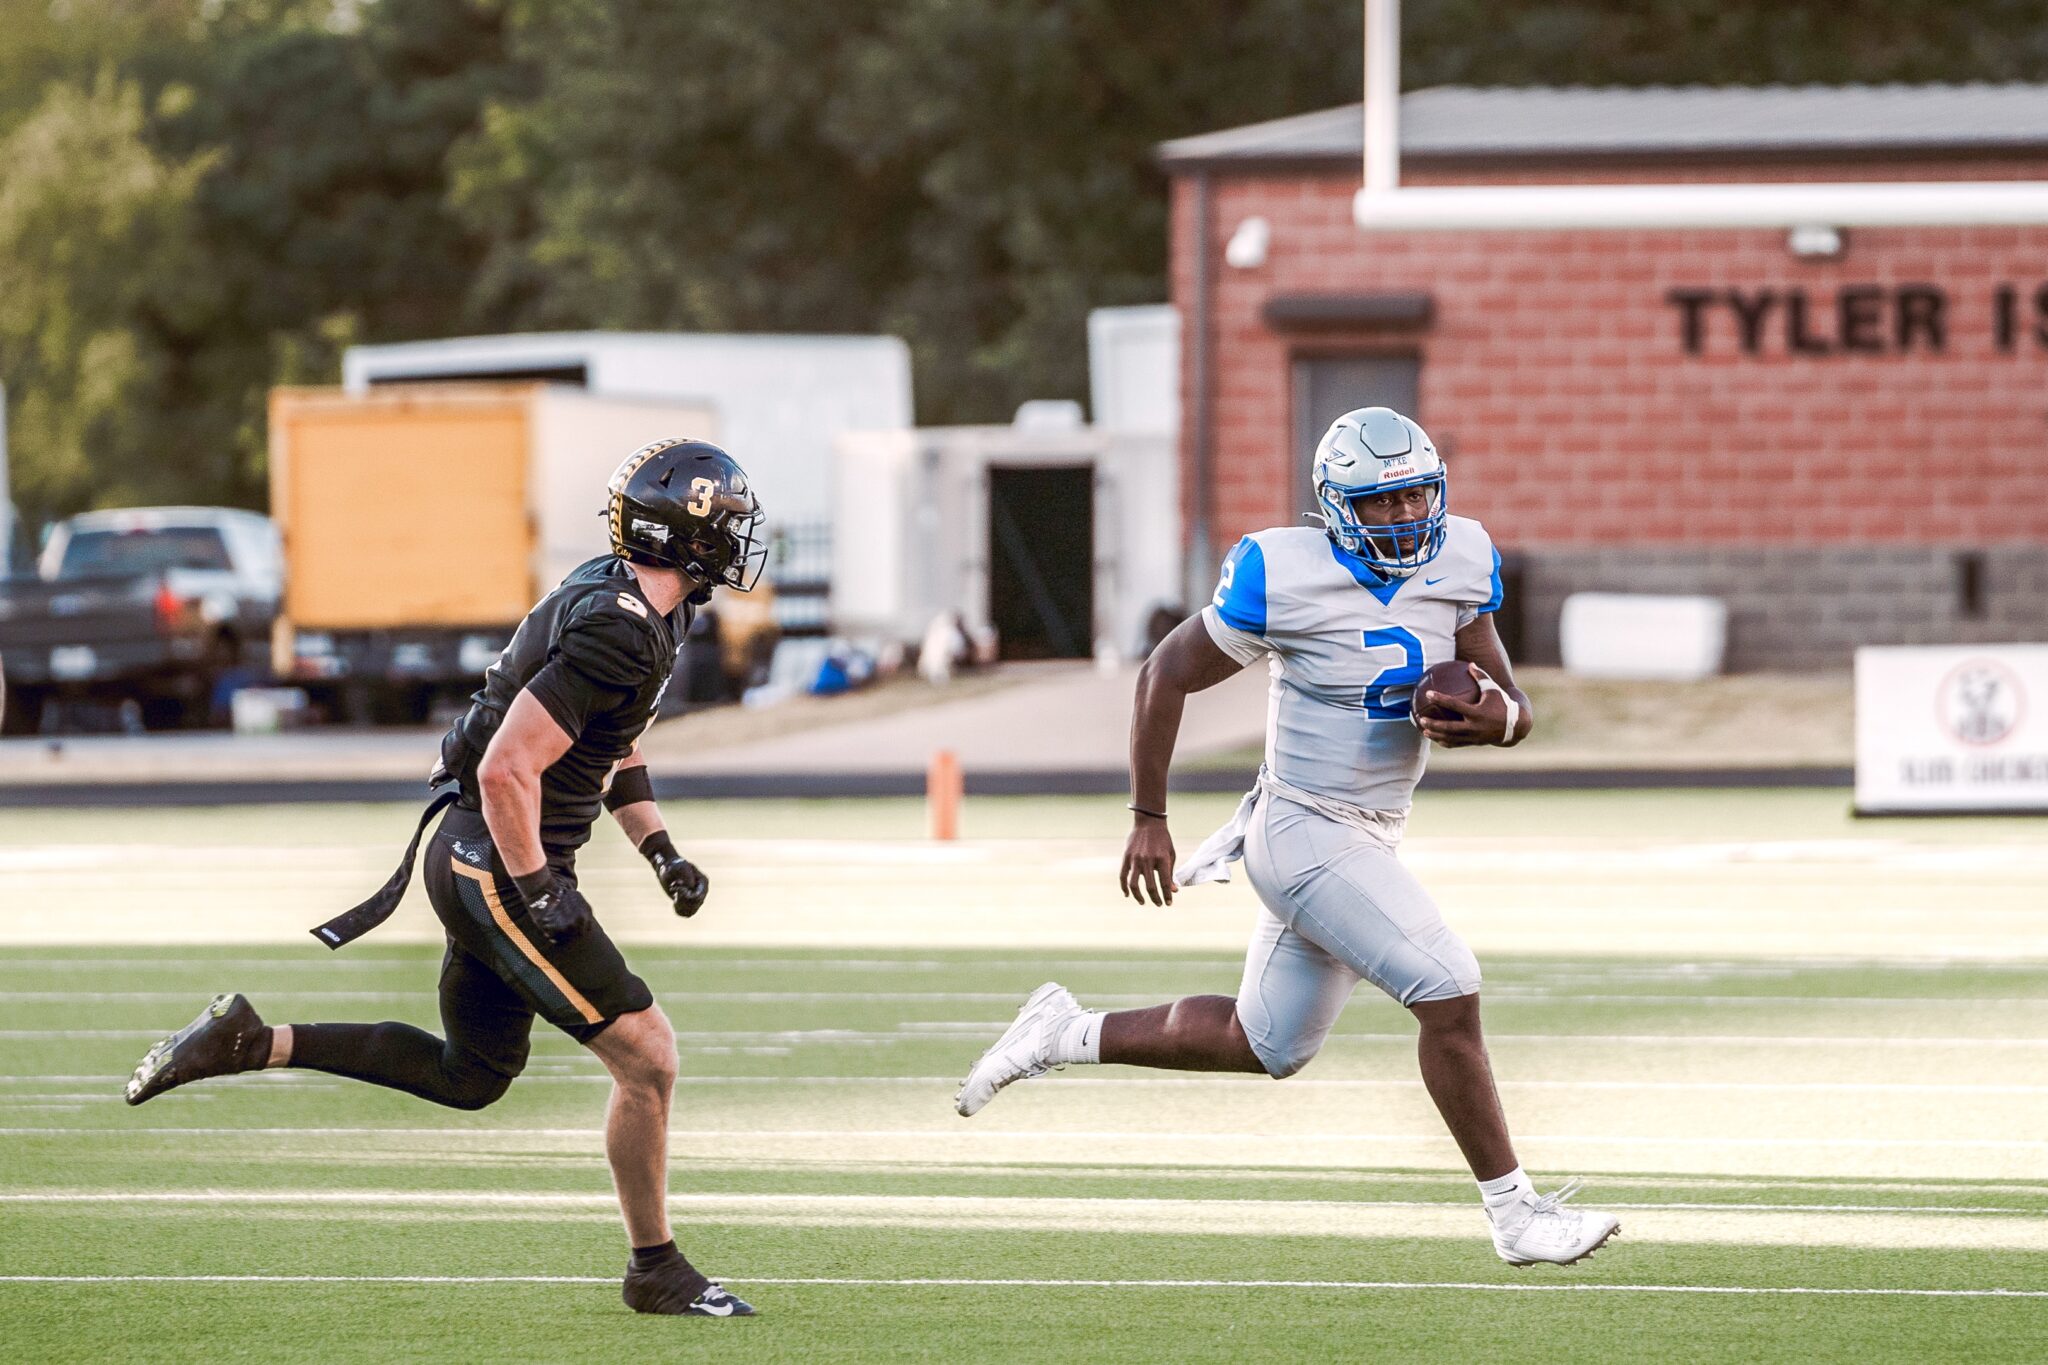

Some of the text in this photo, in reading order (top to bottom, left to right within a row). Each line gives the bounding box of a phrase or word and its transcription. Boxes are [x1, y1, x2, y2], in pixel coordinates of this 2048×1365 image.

[1666, 283, 1948, 355] TYLER
[687, 477, 714, 517] 3
[1384, 467, 1415, 479] Riddell
[1212, 559, 1235, 608] 2
[1360, 624, 1425, 722] 2
